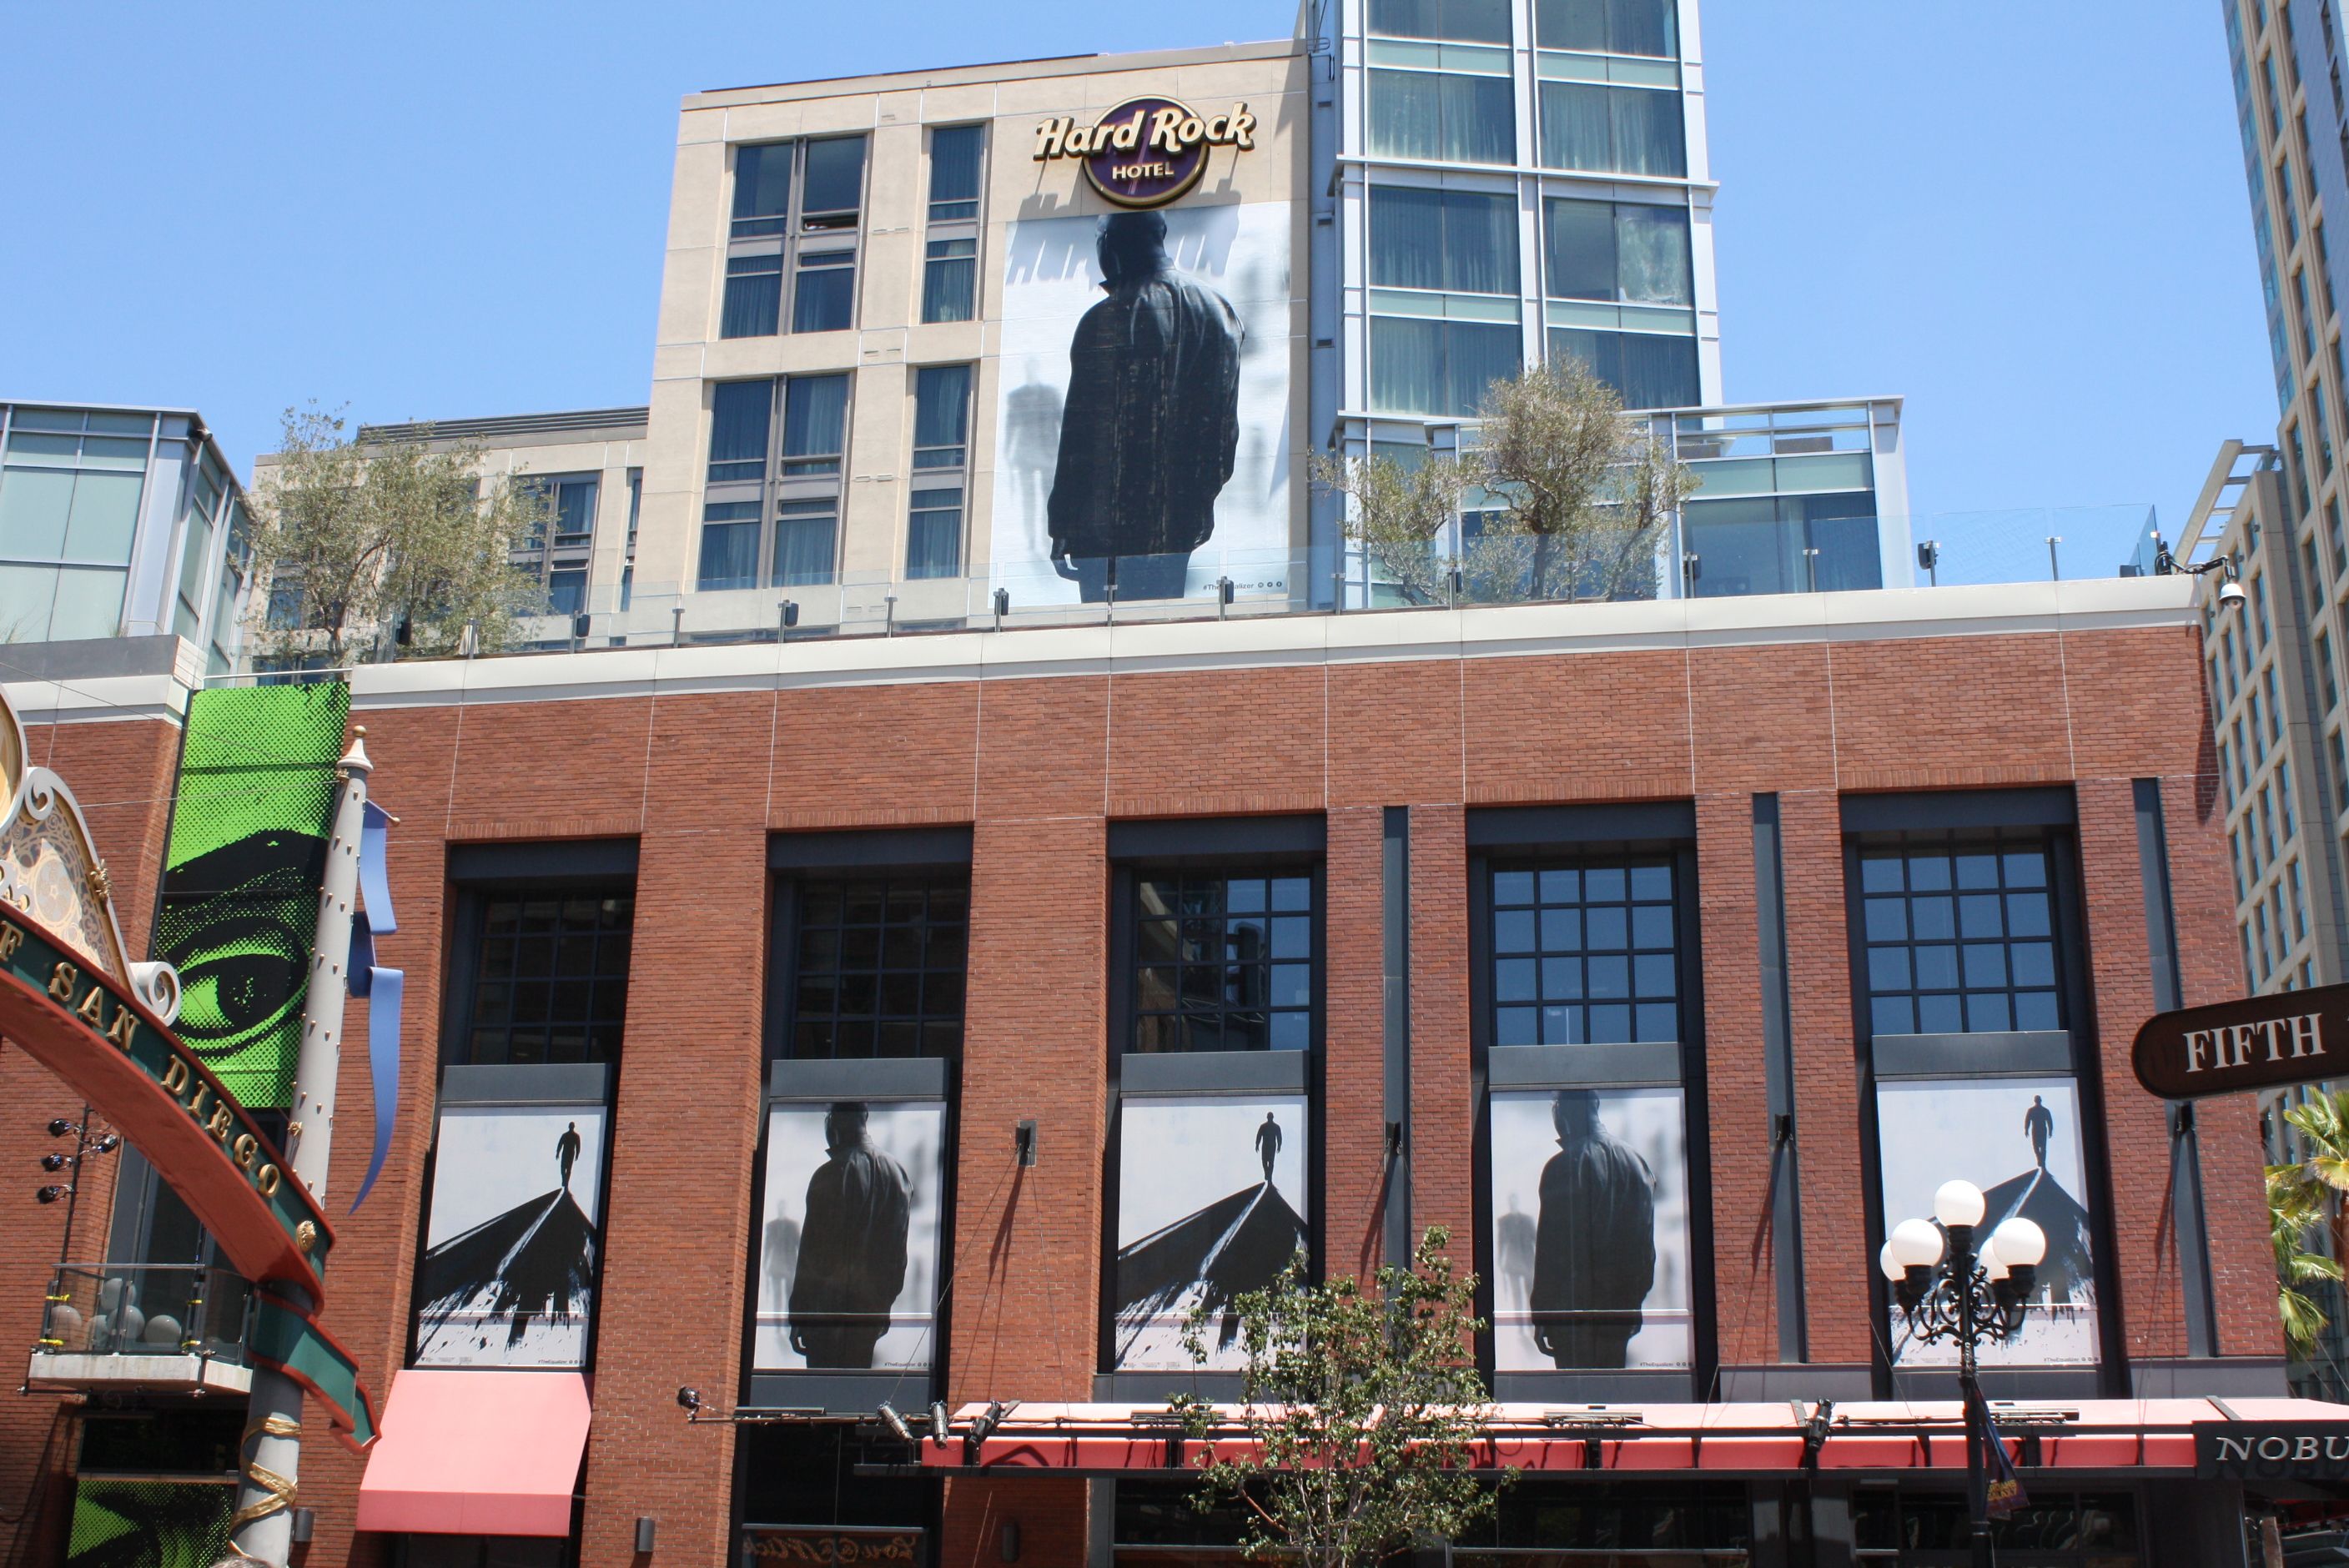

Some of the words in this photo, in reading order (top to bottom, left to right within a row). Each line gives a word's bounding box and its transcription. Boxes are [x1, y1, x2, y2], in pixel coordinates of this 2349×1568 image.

[1033, 109, 1145, 162] Hard
[1149, 101, 1257, 155] Rock
[1112, 161, 1175, 180] HOTEL
[2182, 1013, 2327, 1073] FIFTH
[48, 962, 141, 1051] SAN
[161, 1053, 281, 1199] DIEGO
[2216, 1436, 2349, 1460] NOBU
